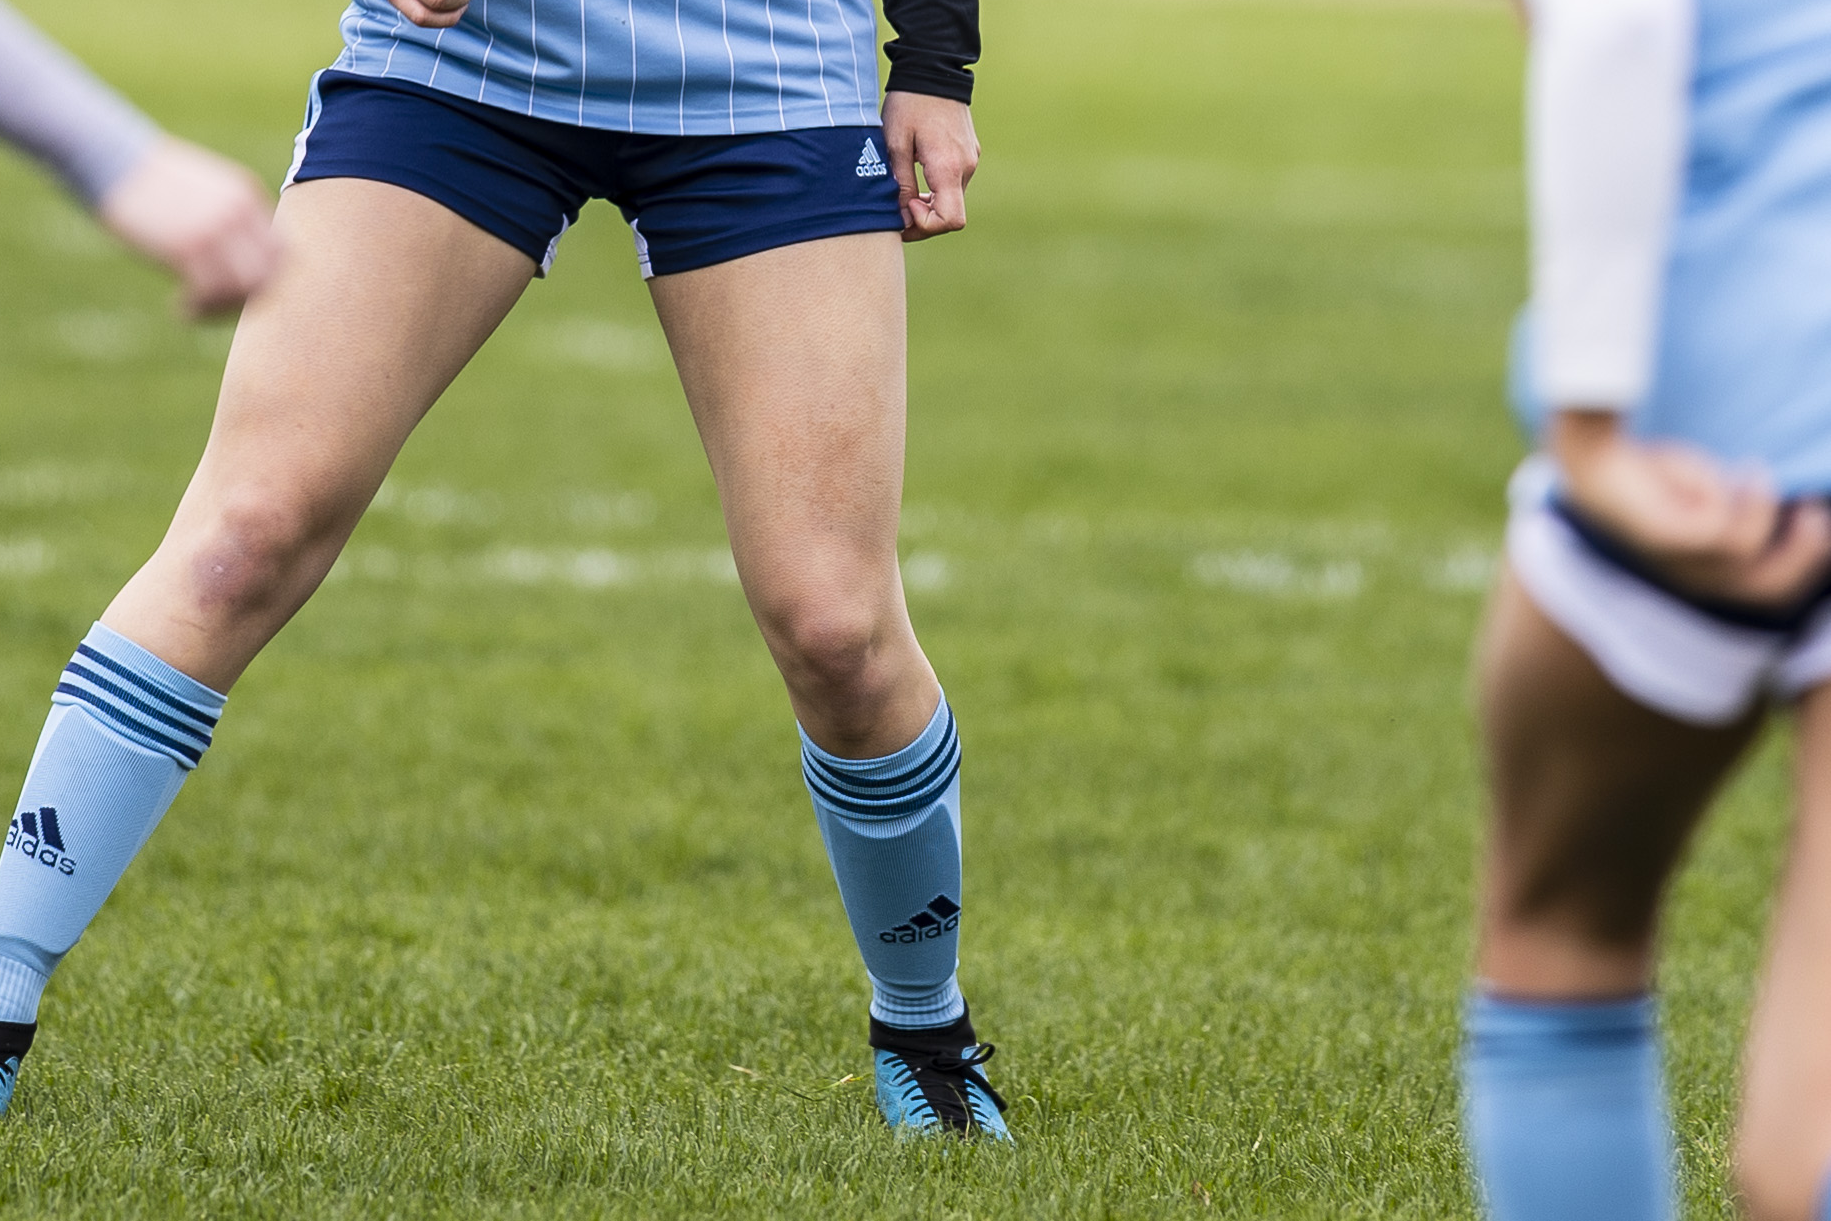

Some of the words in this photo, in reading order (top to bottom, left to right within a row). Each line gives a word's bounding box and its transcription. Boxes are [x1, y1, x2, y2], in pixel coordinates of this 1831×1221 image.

[856, 161, 887, 177] adidas
[6, 826, 76, 875] didas
[880, 912, 961, 943] adida
